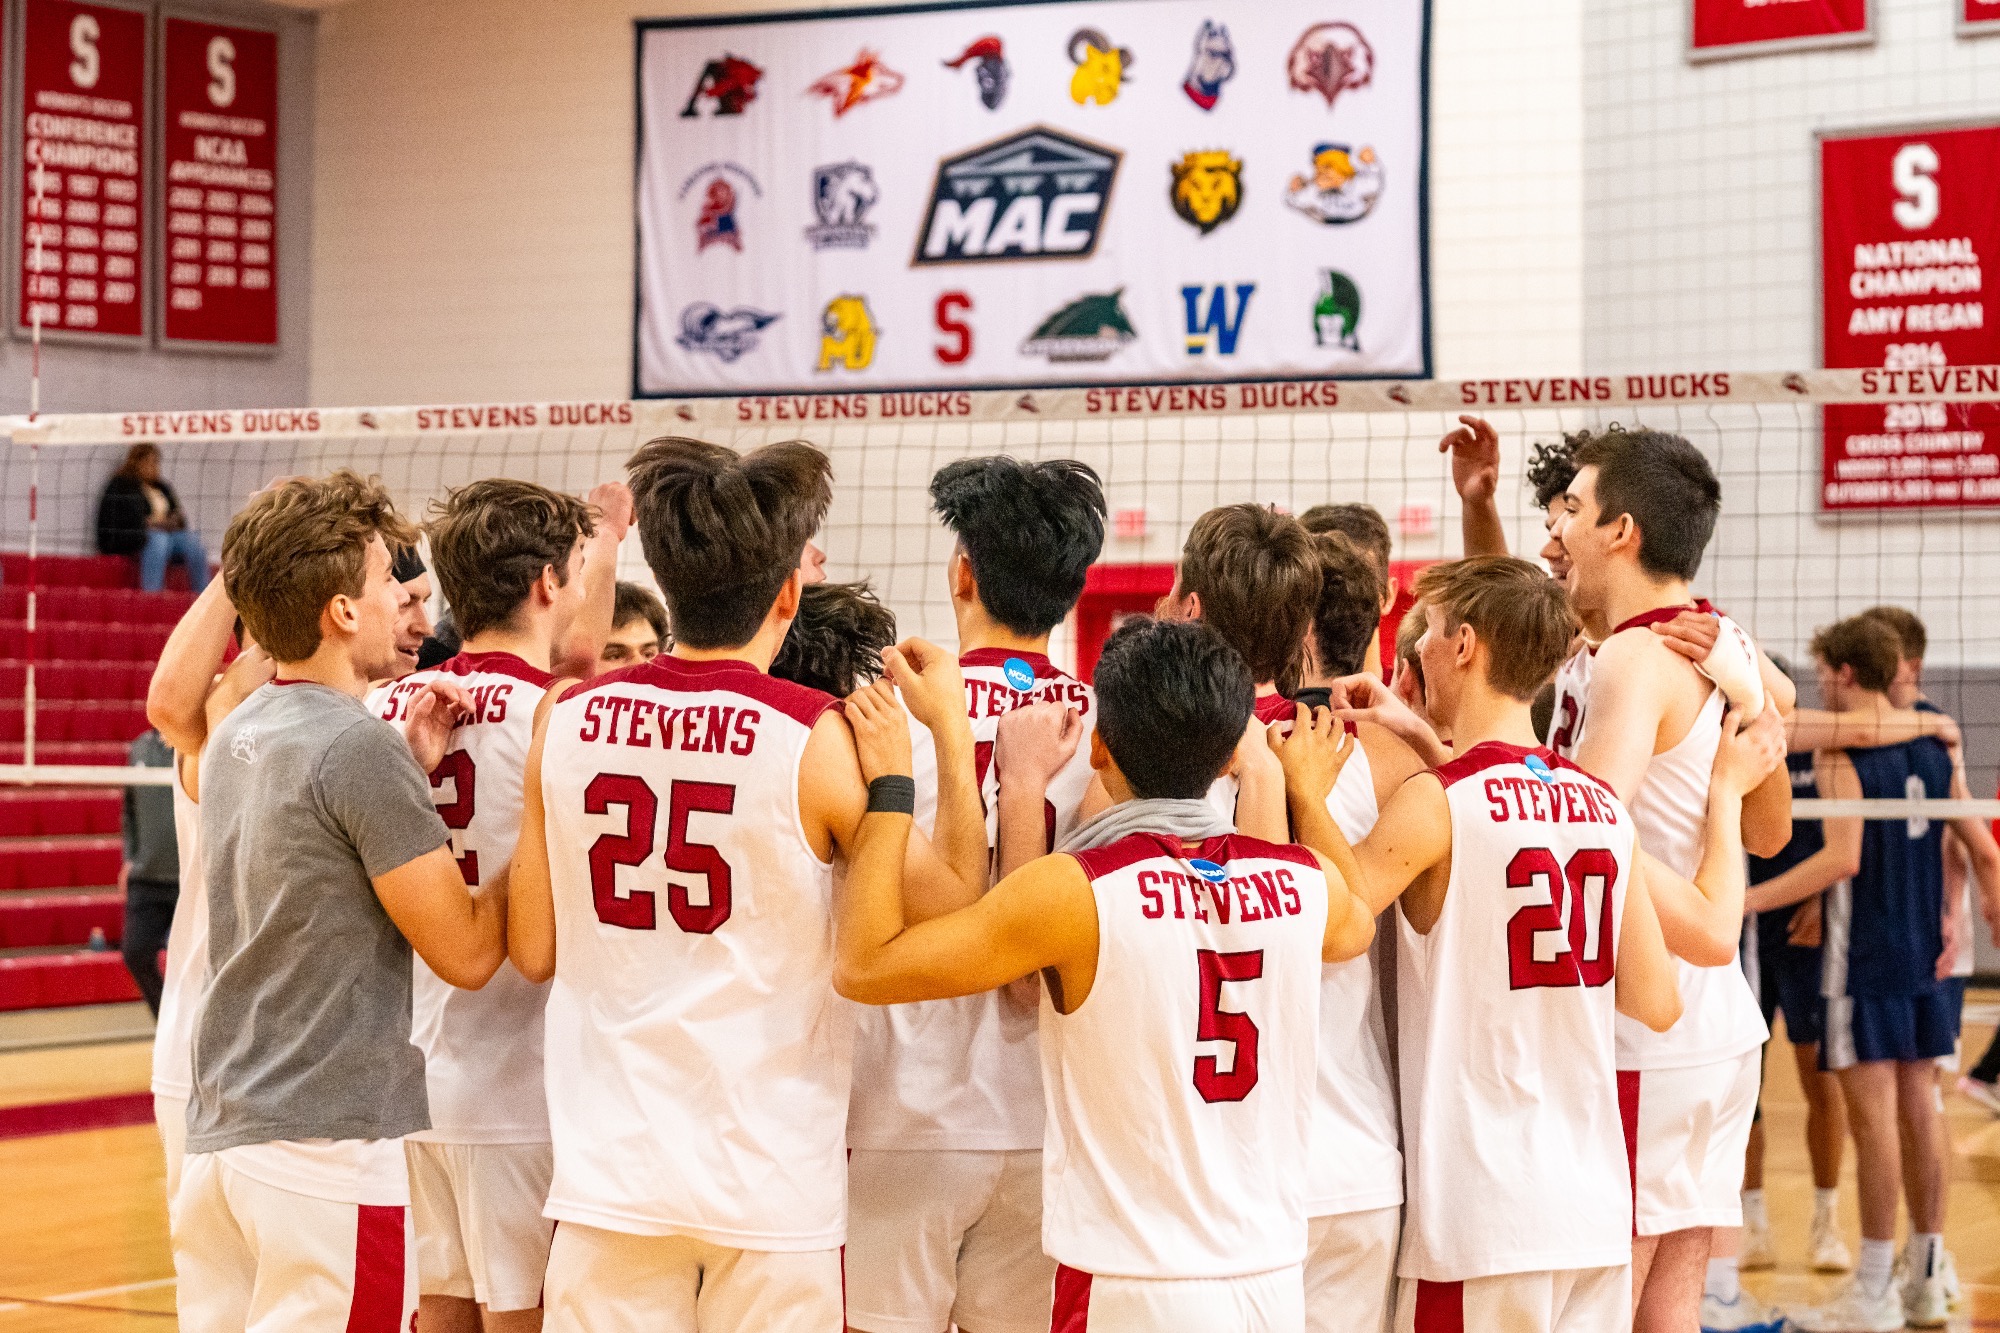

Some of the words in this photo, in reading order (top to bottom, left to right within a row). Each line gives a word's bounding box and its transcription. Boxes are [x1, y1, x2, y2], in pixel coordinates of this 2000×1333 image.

[69, 14, 100, 88] S
[207, 36, 236, 107] S
[194, 135, 248, 165] NCAA
[1892, 143, 1940, 229] S
[924, 192, 1100, 258] MAC
[1854, 238, 1978, 270] NATIONAL
[1850, 266, 1981, 299] CHAMPION
[934, 290, 973, 364] S
[1848, 306, 1904, 336] AMY
[1906, 302, 1984, 333] REGAN
[1085, 386, 1226, 413] STEVENS
[1240, 382, 1339, 408] DUCKS
[1460, 378, 1611, 404] STEVENS
[1626, 373, 1730, 399] DUCKS
[1862, 369, 2000, 394] STEVEN
[122, 414, 232, 435] STEVENS
[243, 411, 320, 432] DUCKS
[417, 406, 537, 430] STEVENS
[549, 402, 633, 425] DUCKS
[738, 396, 868, 421] STEVENS
[880, 392, 972, 418] DUCKS
[1008, 668, 1032, 686] NCAA
[580, 695, 760, 756] STEVENS
[1484, 777, 1617, 825] STEVENS
[584, 772, 736, 934] 25
[1137, 868, 1301, 925] STEVENS
[1506, 847, 1618, 990] 20
[1193, 949, 1263, 1104] 5
